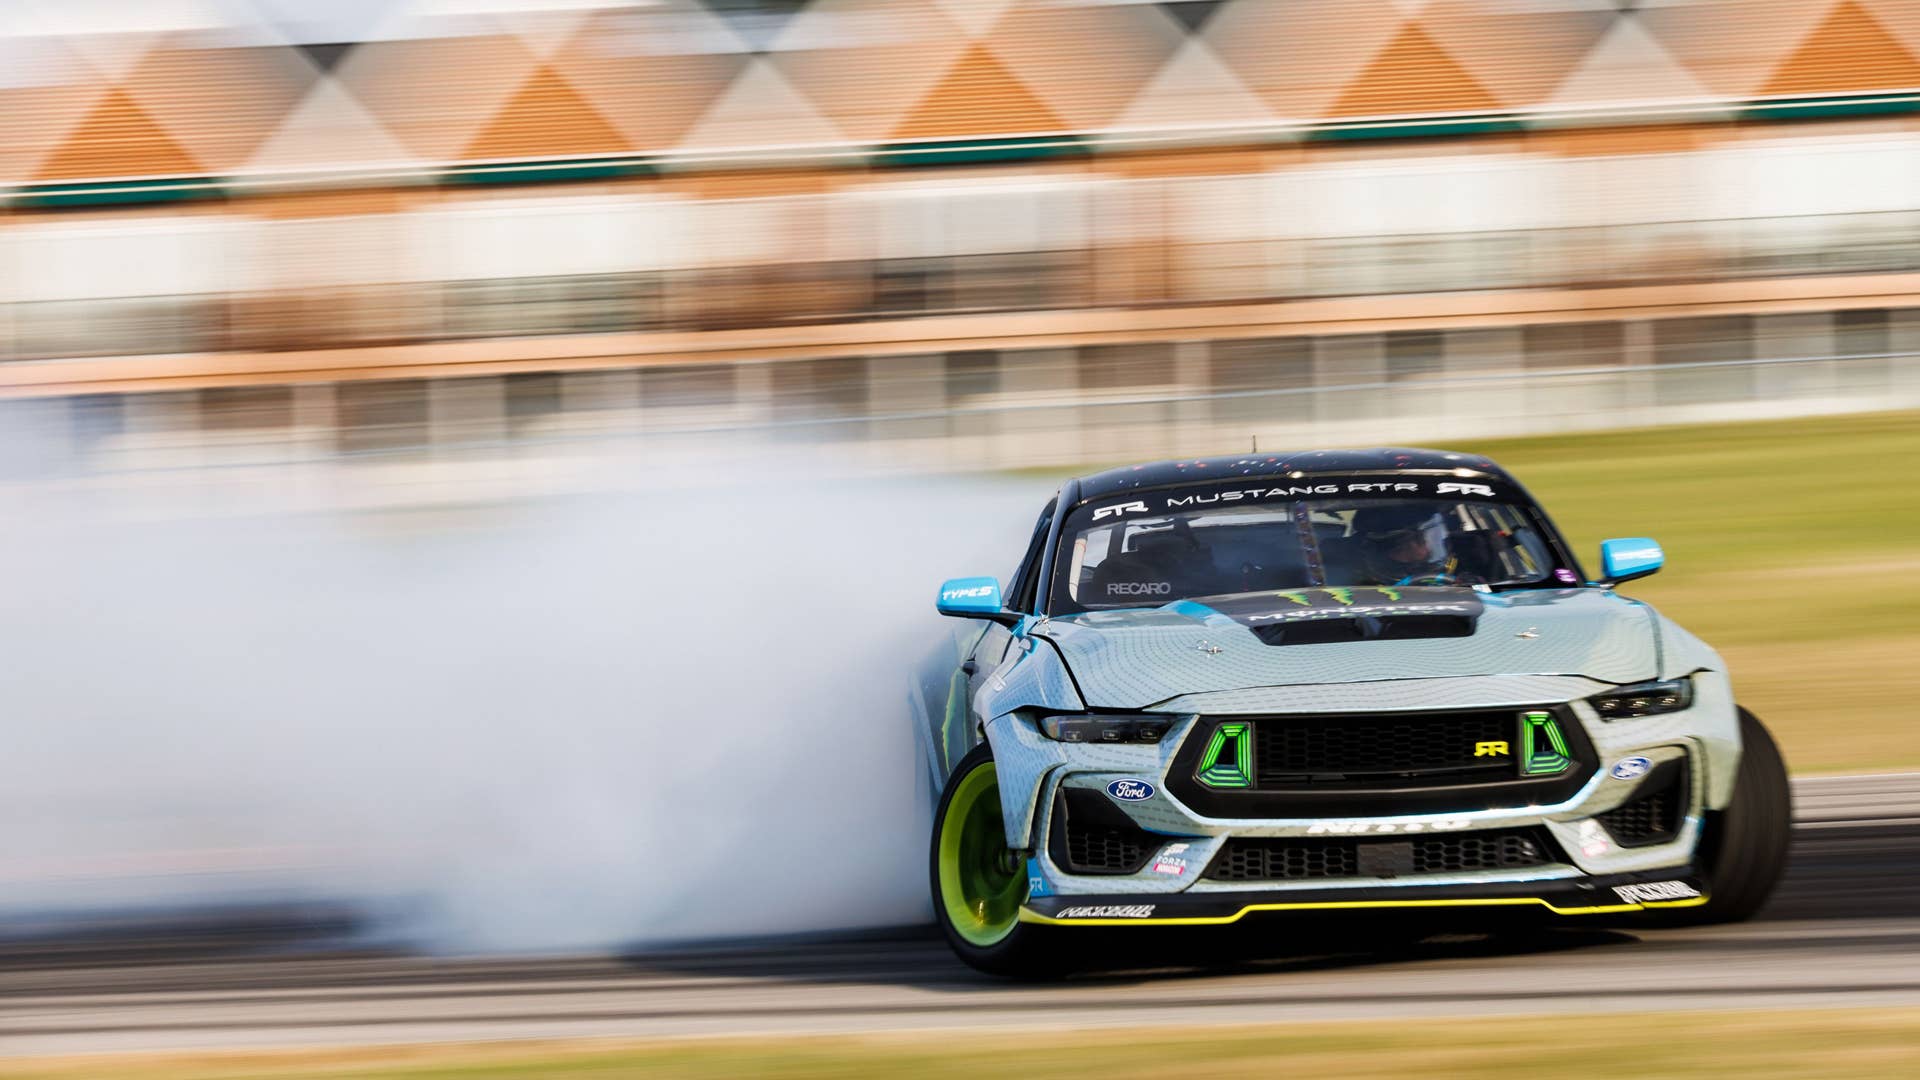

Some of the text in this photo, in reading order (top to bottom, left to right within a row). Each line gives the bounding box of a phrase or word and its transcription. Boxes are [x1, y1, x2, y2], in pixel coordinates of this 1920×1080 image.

[1167, 482, 1419, 507] MUSTANG RTR
[1107, 582, 1171, 595] RECARO
[1116, 781, 1145, 798] Ford
[1156, 855, 1187, 867] FORZA
